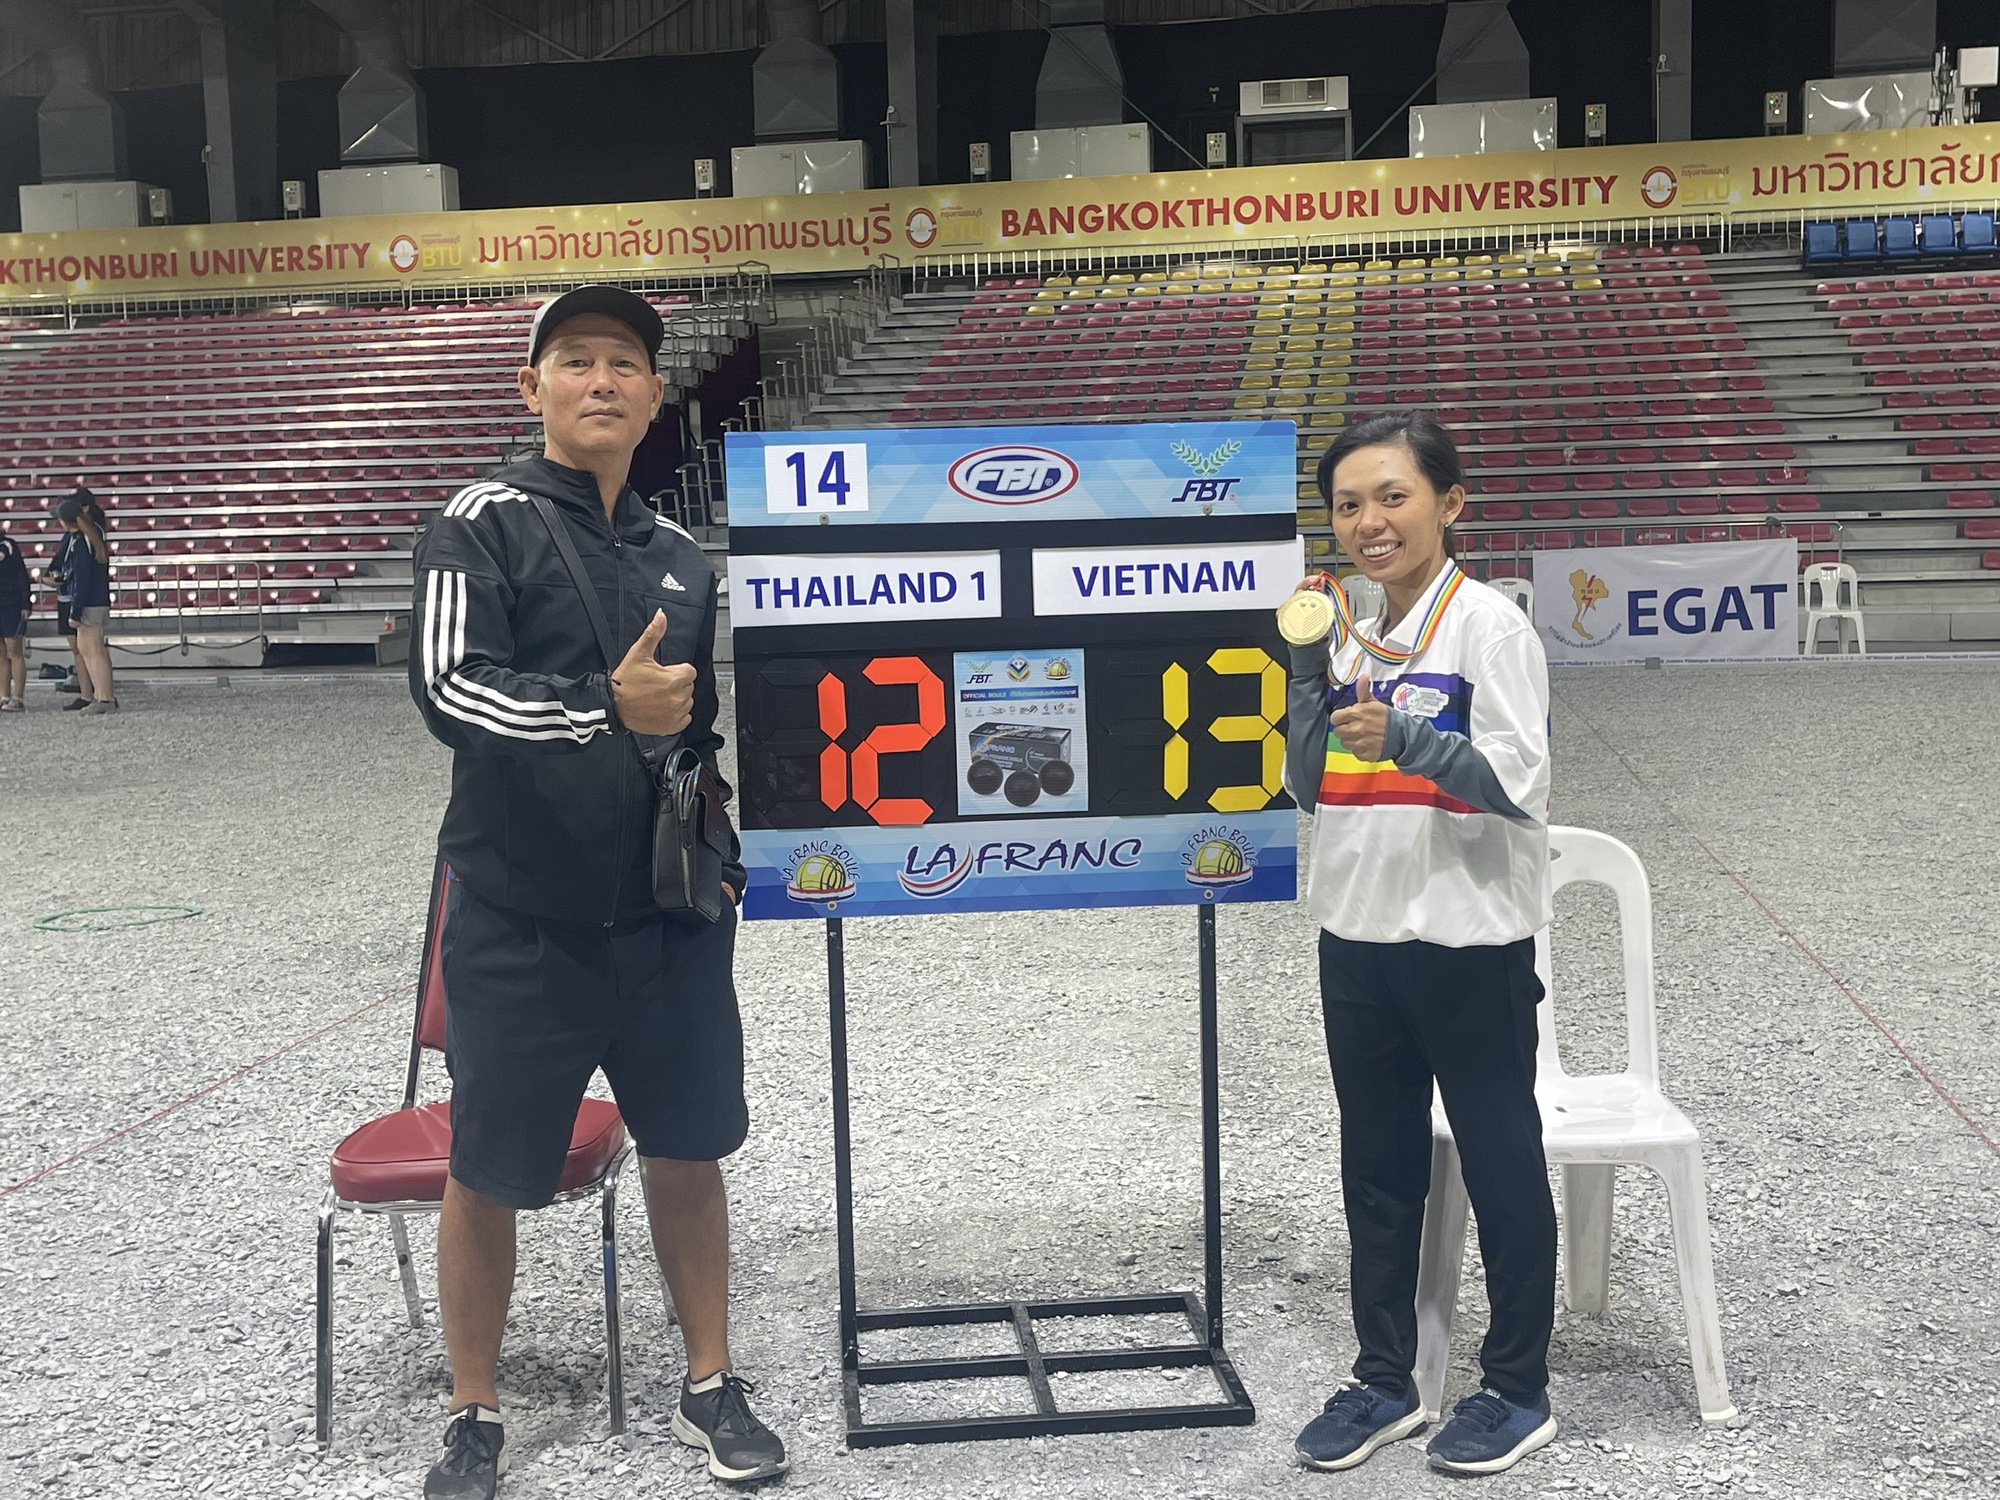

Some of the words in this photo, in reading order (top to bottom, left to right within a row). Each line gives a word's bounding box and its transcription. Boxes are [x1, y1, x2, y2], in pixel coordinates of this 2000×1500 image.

[1001, 188, 1379, 237] BANGKOKTHONBURI
[1394, 175, 1618, 215] UNIVERSITY
[478, 203, 893, 264] มหาวิทยาลัยกรุงเทพธนบุรี
[190, 242, 371, 277] UNIVERSITY
[422, 245, 462, 268] BTU
[785, 451, 851, 506] 14
[1171, 478, 1241, 503] FBT
[746, 571, 957, 609] THAILAND
[970, 571, 985, 601] 1
[1072, 560, 1256, 598] VIETNAM
[1627, 583, 1788, 637] EGAT
[966, 674, 993, 684] FBT
[817, 656, 947, 826] 12
[1162, 647, 1287, 813] 13
[789, 840, 828, 866] FRANC
[831, 844, 860, 880] BOULE
[906, 843, 957, 875] LA
[975, 838, 1142, 874] FRANC
[1188, 826, 1227, 851] FRANC
[1229, 829, 1258, 866] BOULE
